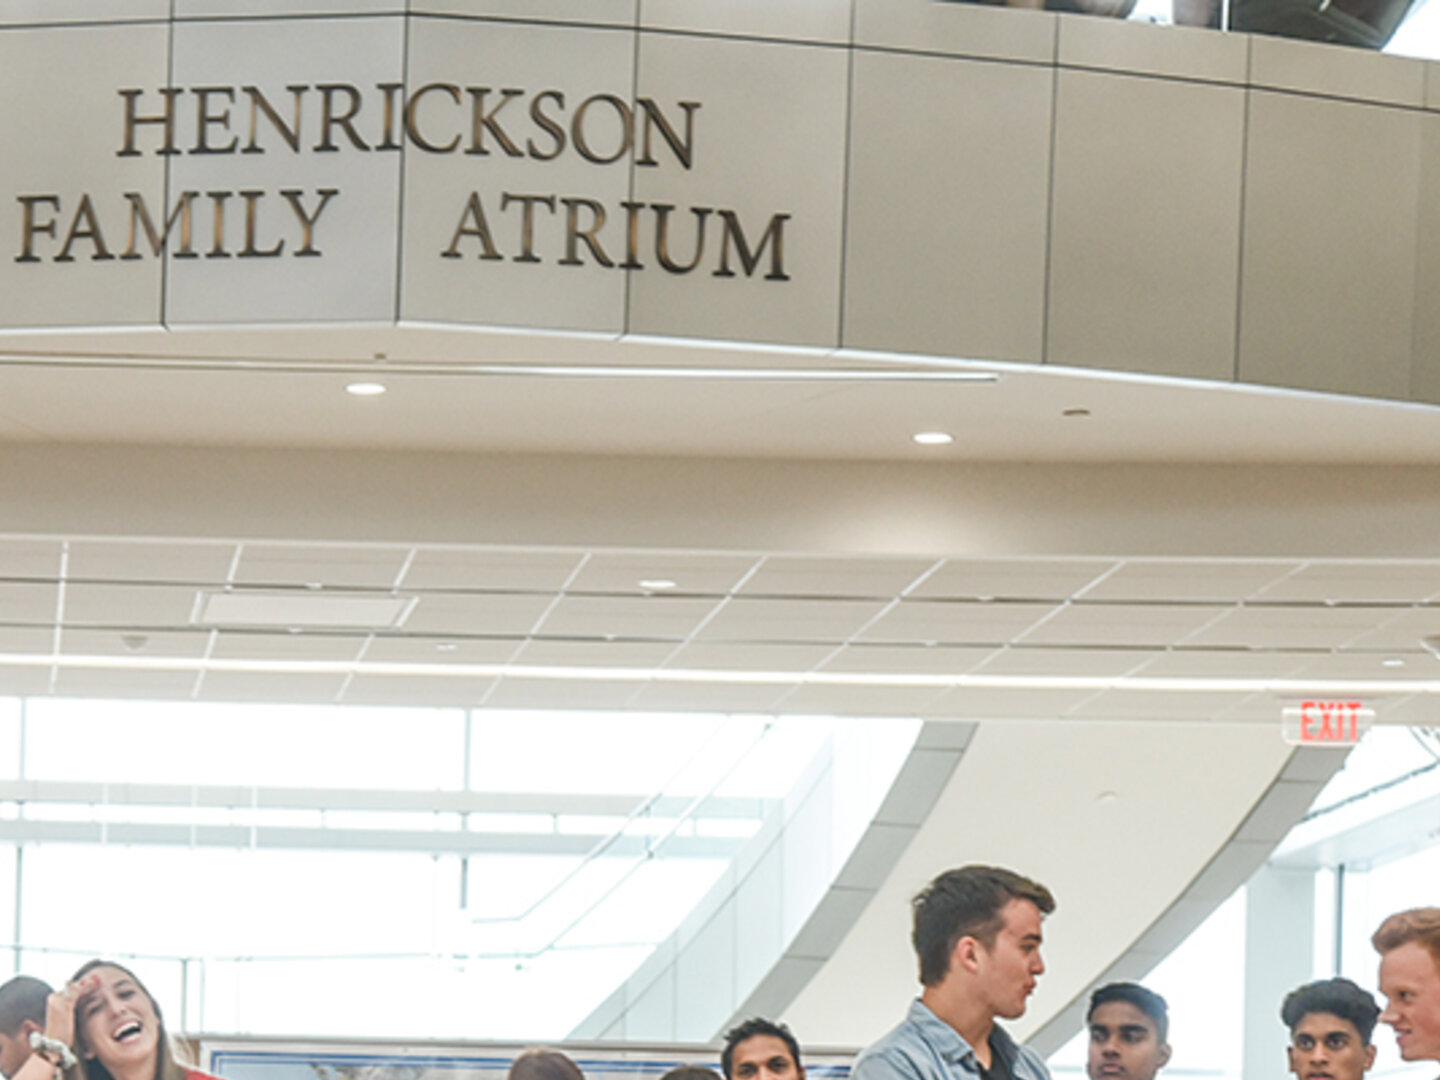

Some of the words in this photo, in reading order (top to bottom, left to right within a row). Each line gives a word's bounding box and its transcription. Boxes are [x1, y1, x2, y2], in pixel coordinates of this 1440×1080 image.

[116, 82, 702, 169] HENRICKSON
[14, 188, 339, 263] FAMILY
[440, 191, 791, 282] ATRIUM
[1300, 701, 1363, 742] EXIT
